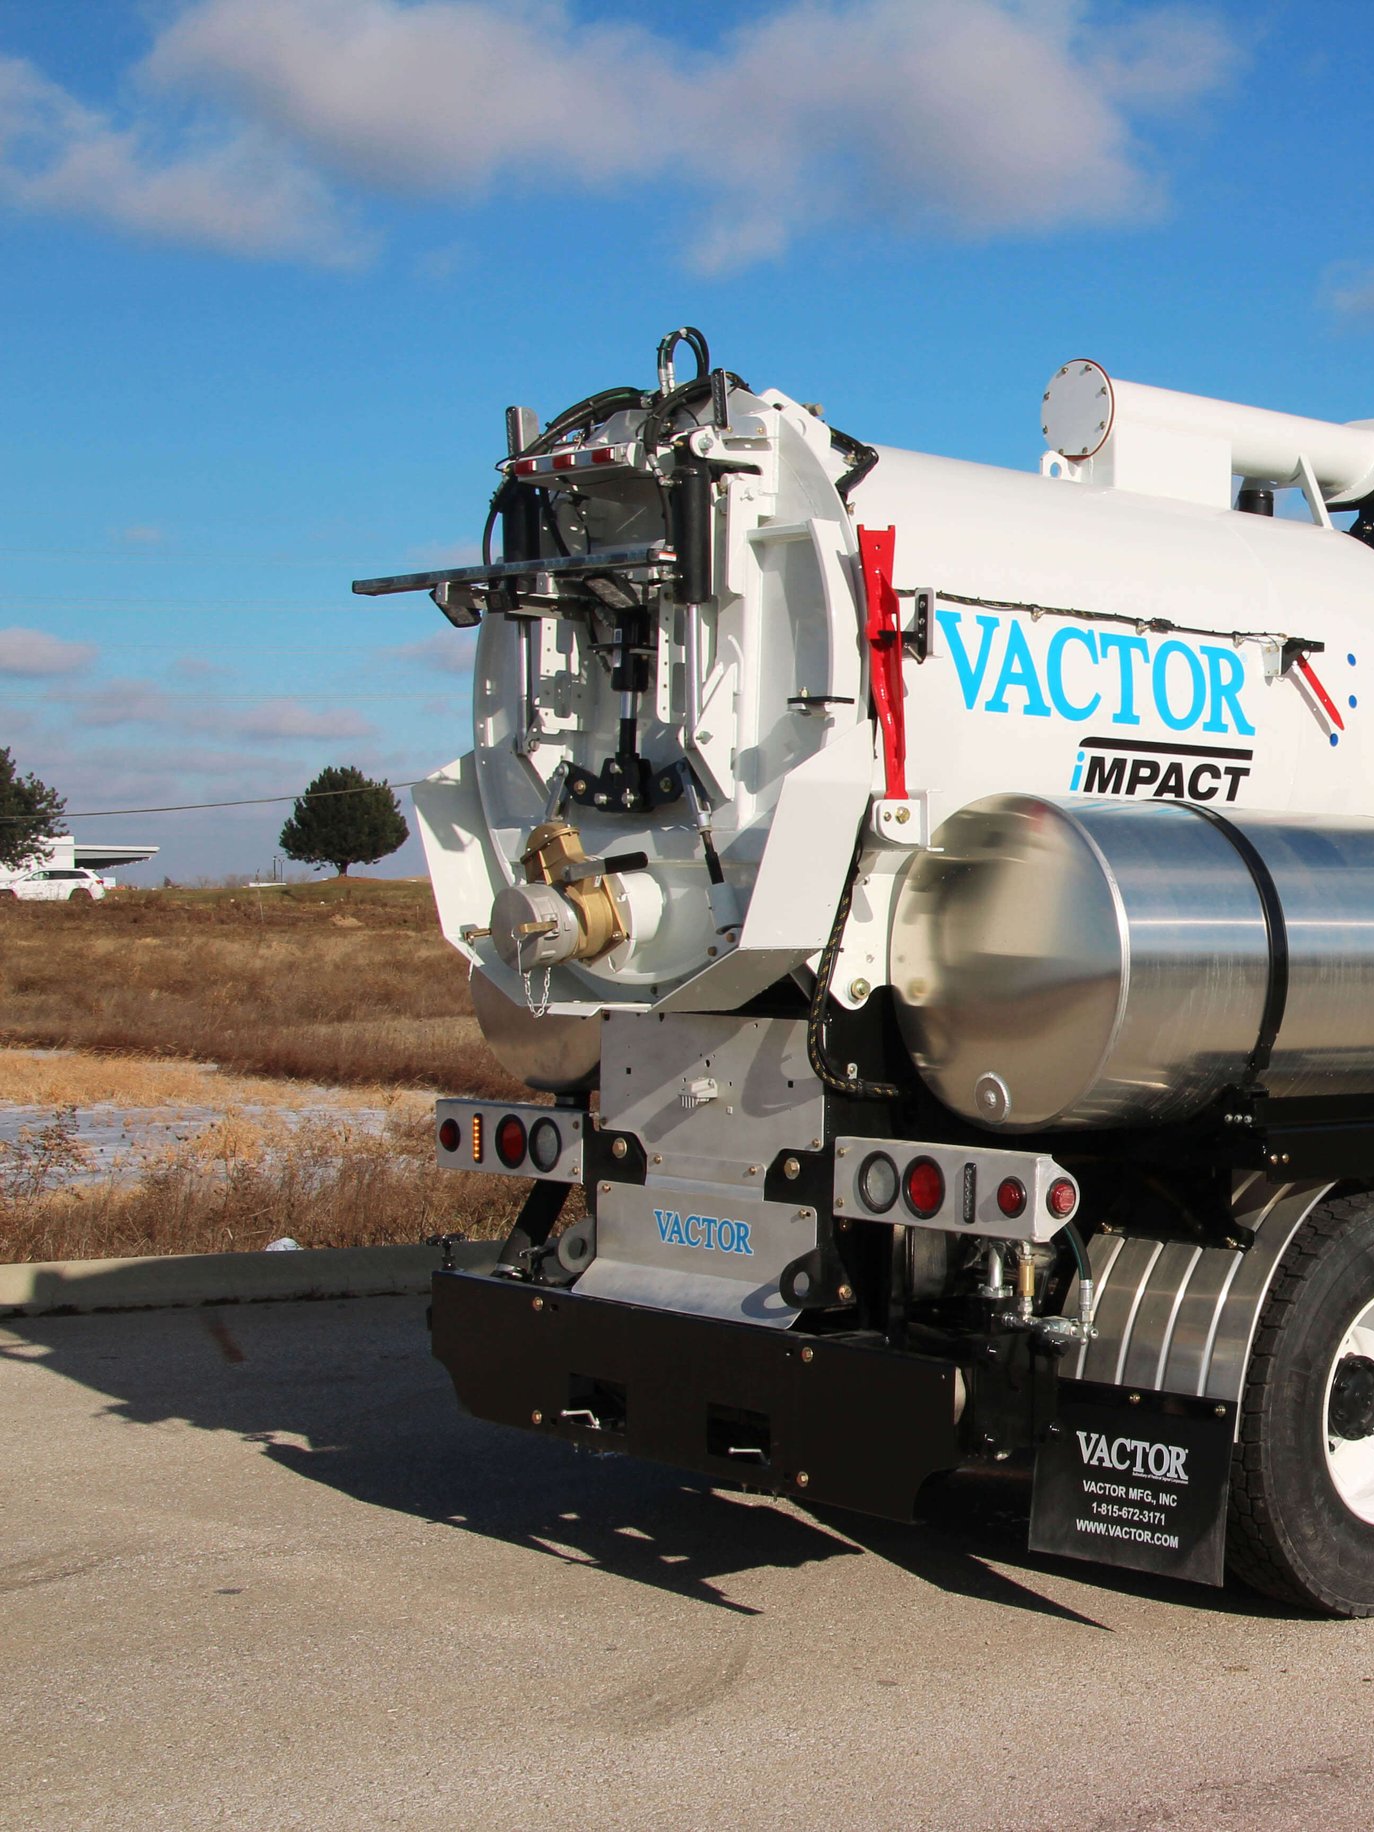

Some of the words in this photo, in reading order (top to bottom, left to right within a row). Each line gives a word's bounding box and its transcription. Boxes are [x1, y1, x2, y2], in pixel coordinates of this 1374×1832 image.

[935, 609, 1256, 737] VACTOR
[1069, 751, 1251, 801] iMPACT
[653, 1210, 753, 1254] VACTOR
[1076, 1430, 1189, 1480] VACTOR
[1083, 1479, 1126, 1499] VACTOR
[1128, 1488, 1157, 1506] MFG.,
[1159, 1492, 1178, 1507] INC
[1091, 1501, 1166, 1526] 1-815-672-3171
[1076, 1518, 1179, 1549] WWW.VACTOR.COM
